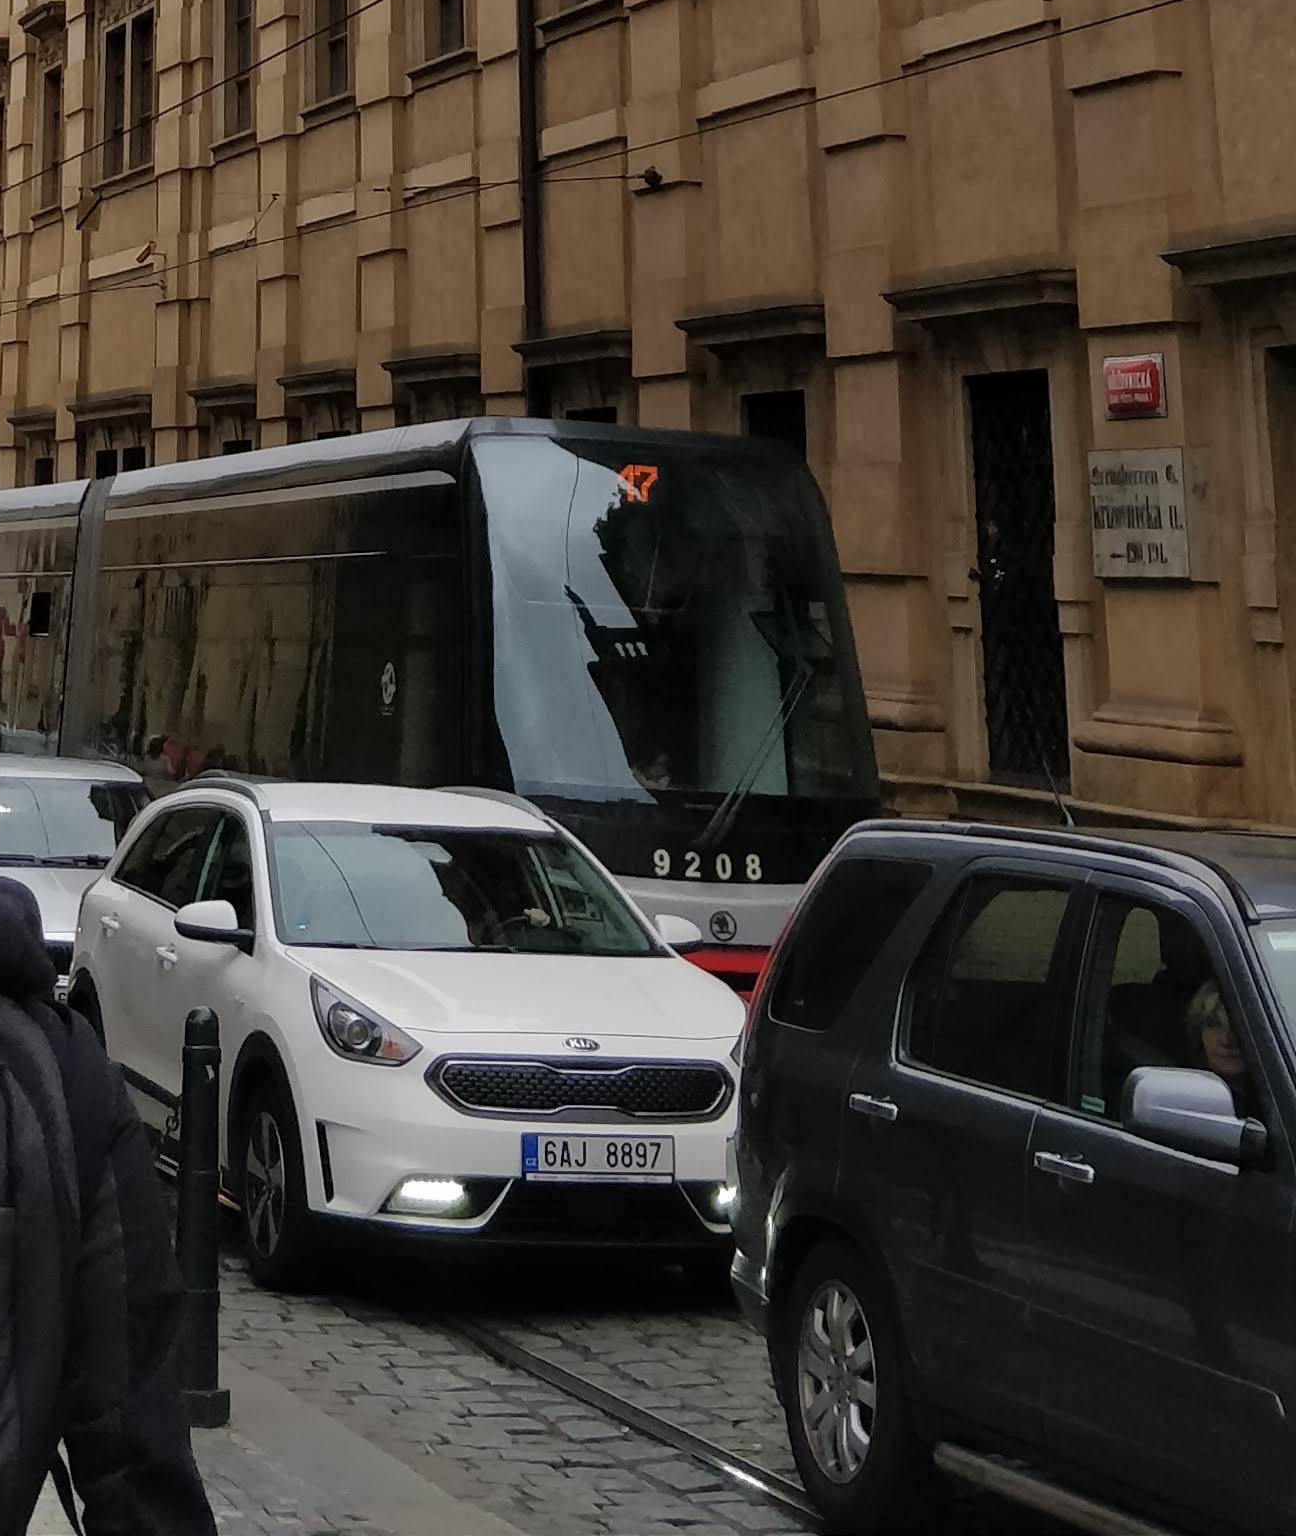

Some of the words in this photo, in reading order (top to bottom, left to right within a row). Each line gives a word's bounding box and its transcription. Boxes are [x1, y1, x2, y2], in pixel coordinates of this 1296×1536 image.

[653, 848, 763, 881] 9208
[568, 1038, 597, 1049] KIA
[544, 1140, 587, 1168] 6AJ
[606, 1142, 662, 1169] 8897
